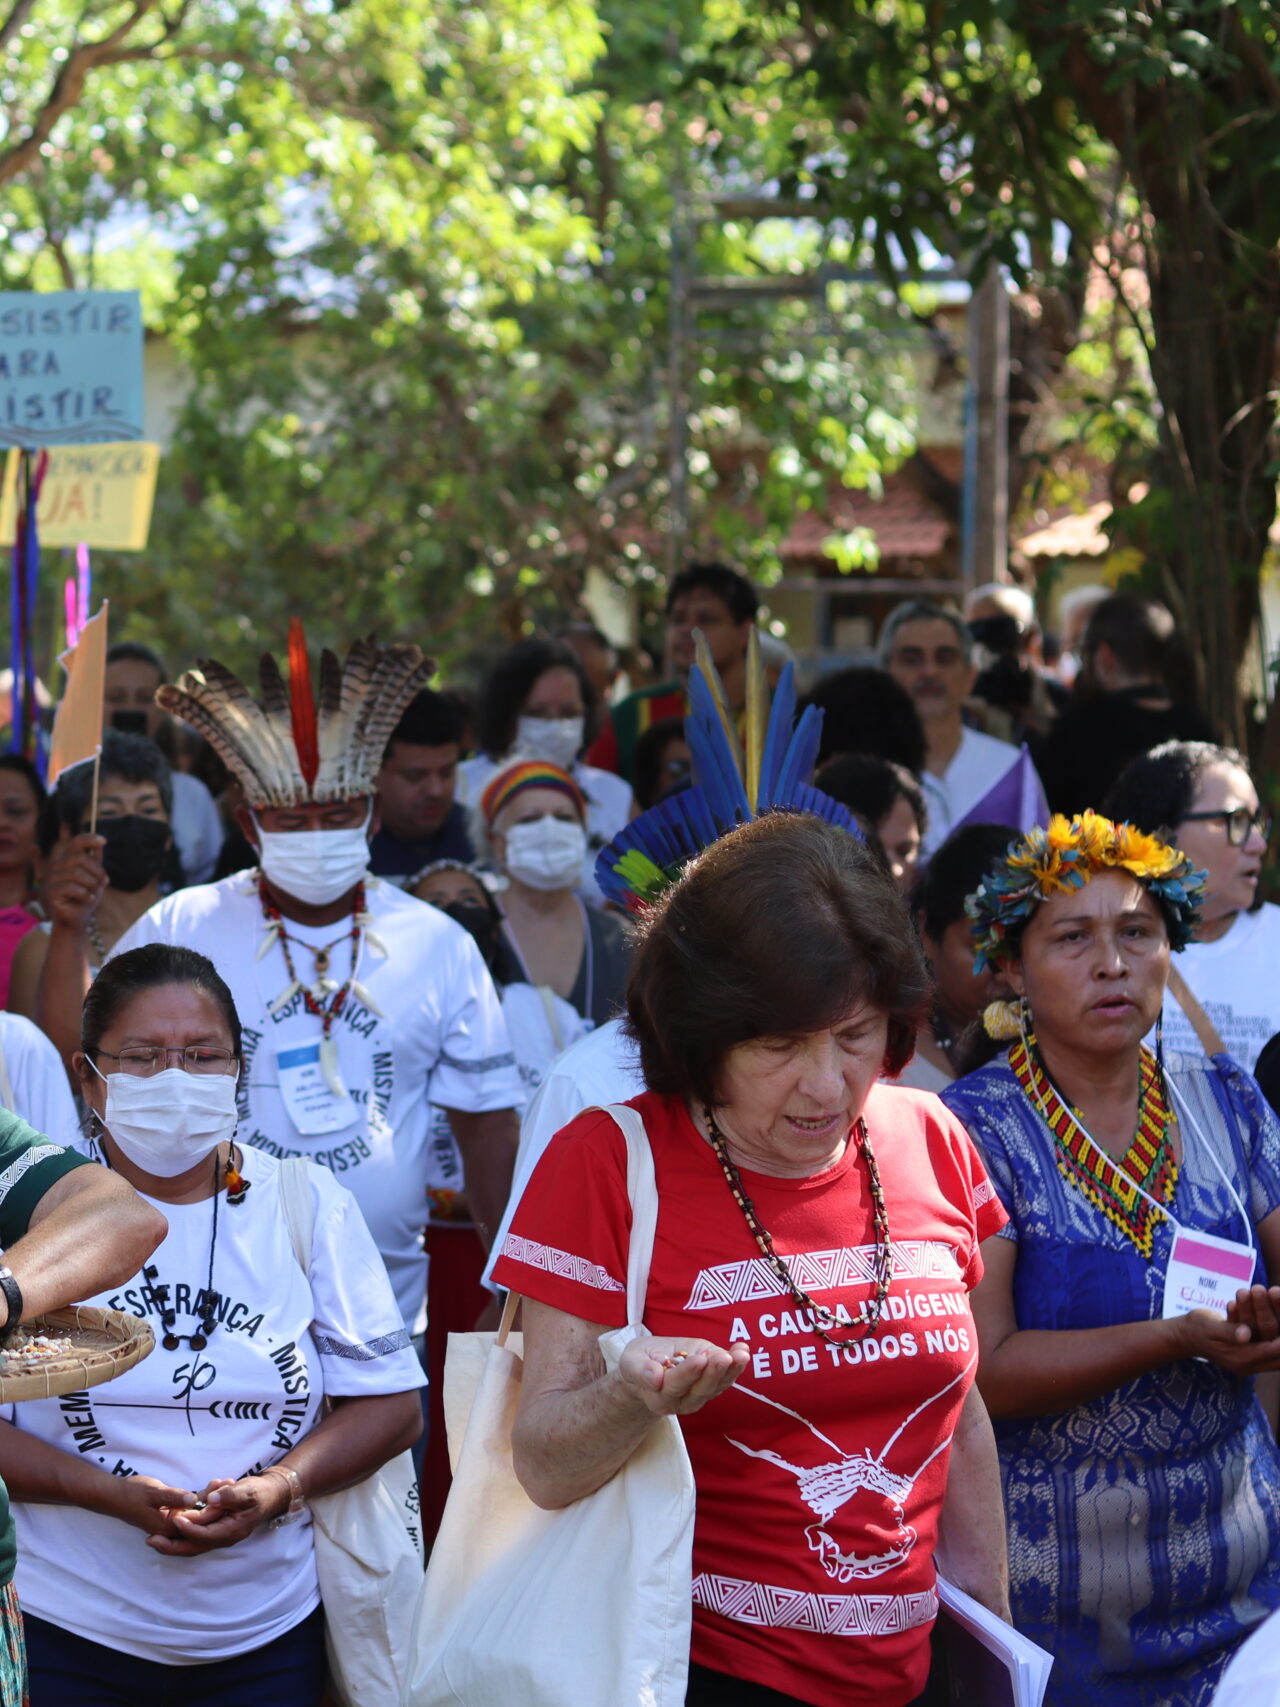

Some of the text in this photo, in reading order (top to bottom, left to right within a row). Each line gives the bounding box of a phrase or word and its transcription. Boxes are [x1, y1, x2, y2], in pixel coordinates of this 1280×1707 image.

[729, 1289, 970, 1342] A CAUSA INDÍGENA
[752, 1323, 970, 1379] É DE TODOS NÓS
[172, 1361, 216, 1400] 50
[269, 1340, 311, 1451] MÍSTICA
